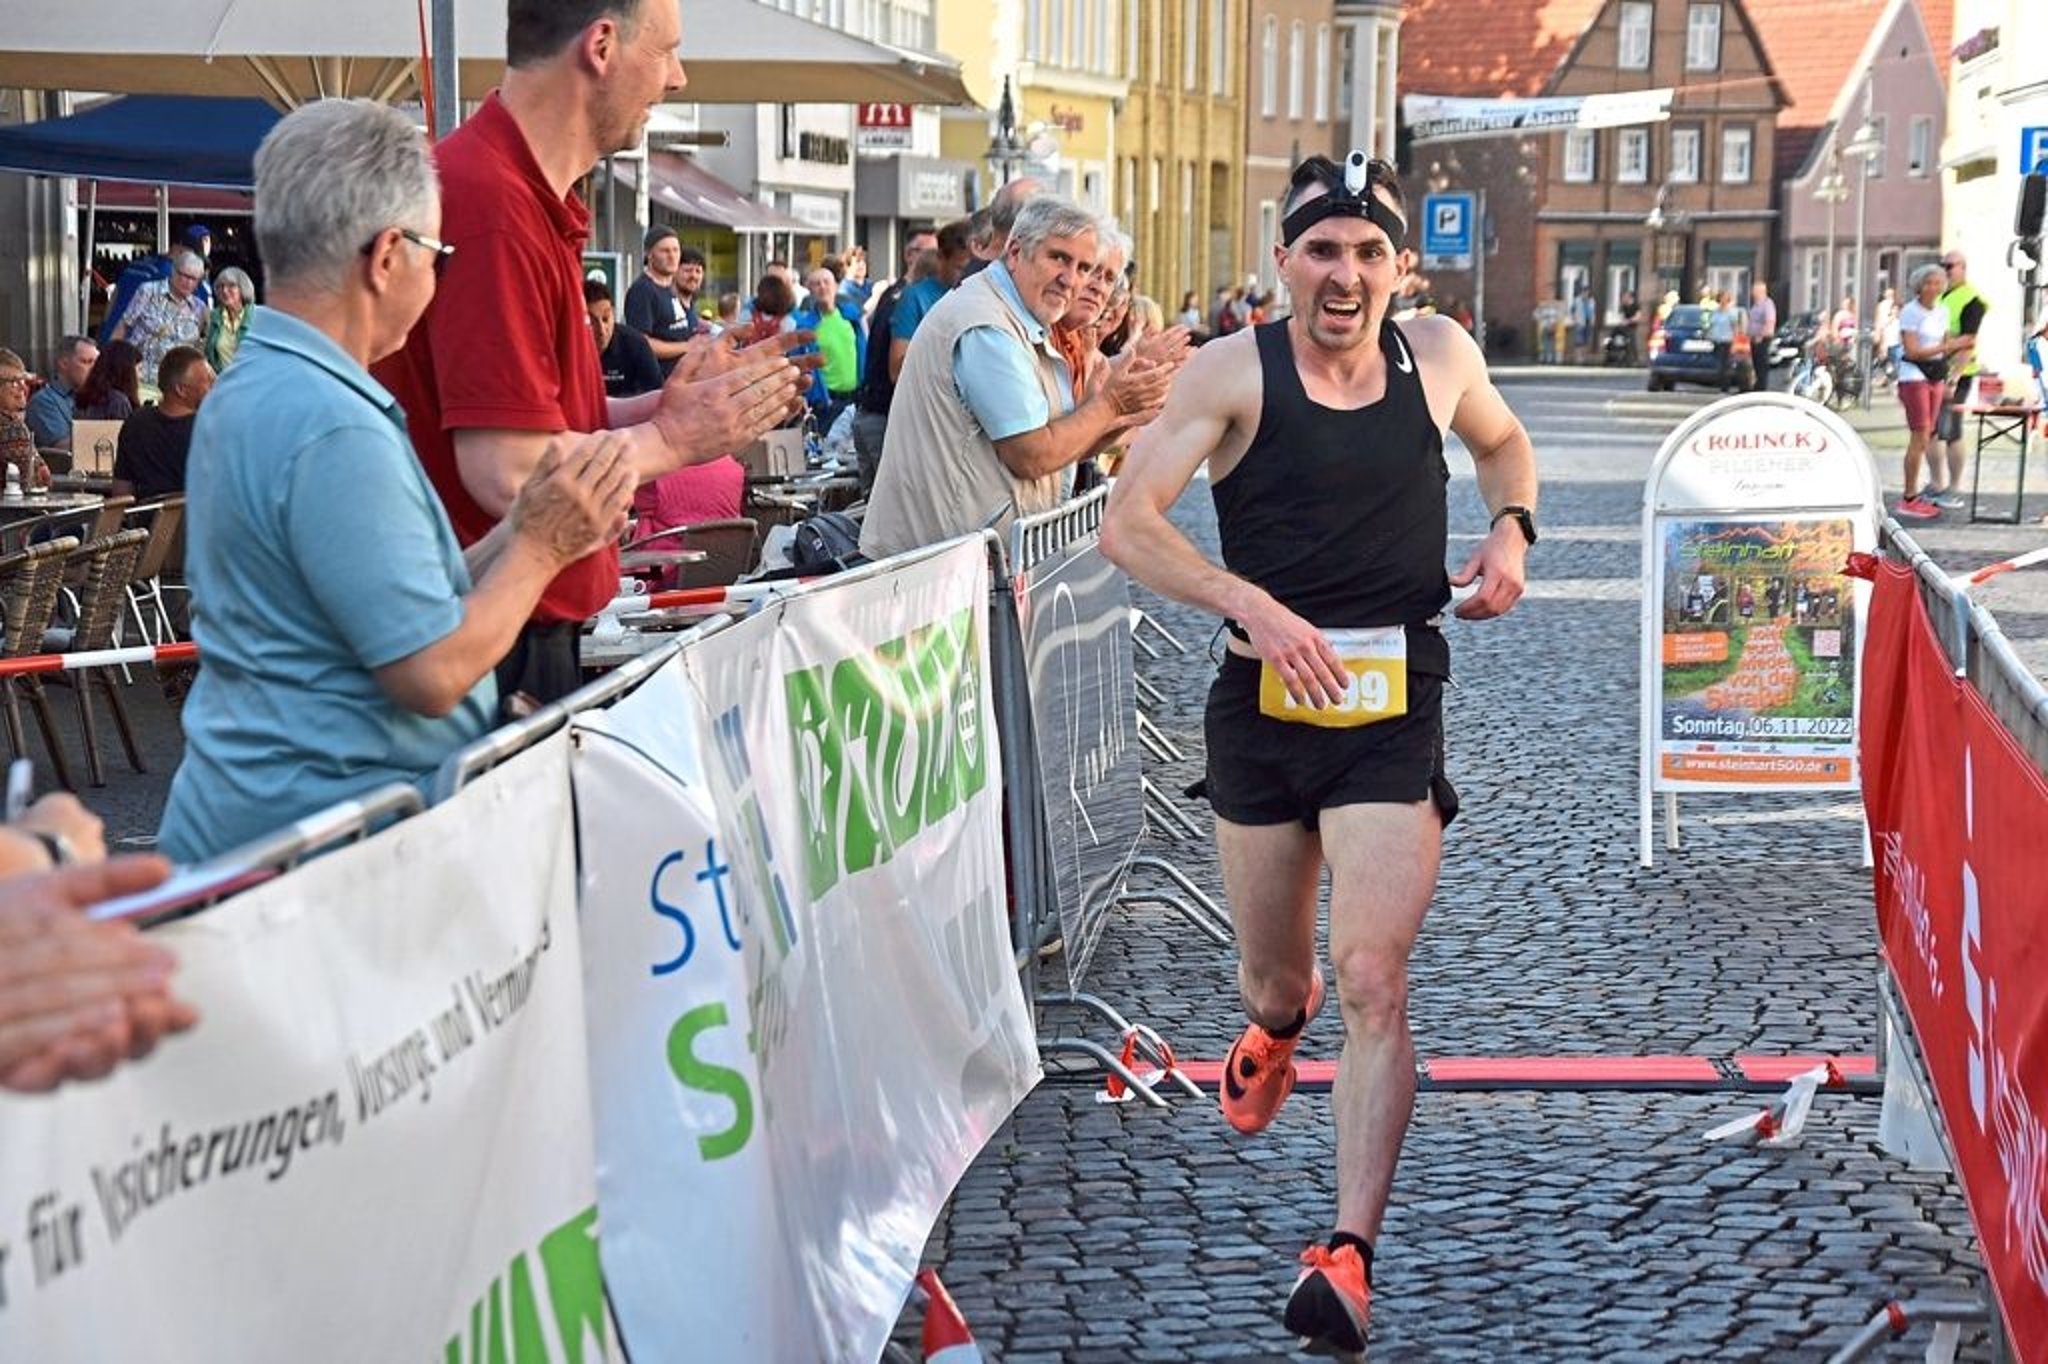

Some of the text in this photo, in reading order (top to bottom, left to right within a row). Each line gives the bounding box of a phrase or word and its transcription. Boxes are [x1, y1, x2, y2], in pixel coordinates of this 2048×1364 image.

[1438, 207, 1457, 230] P
[1708, 432, 1812, 451] ROLINCK
[1751, 718, 1851, 735] 06.11.2022
